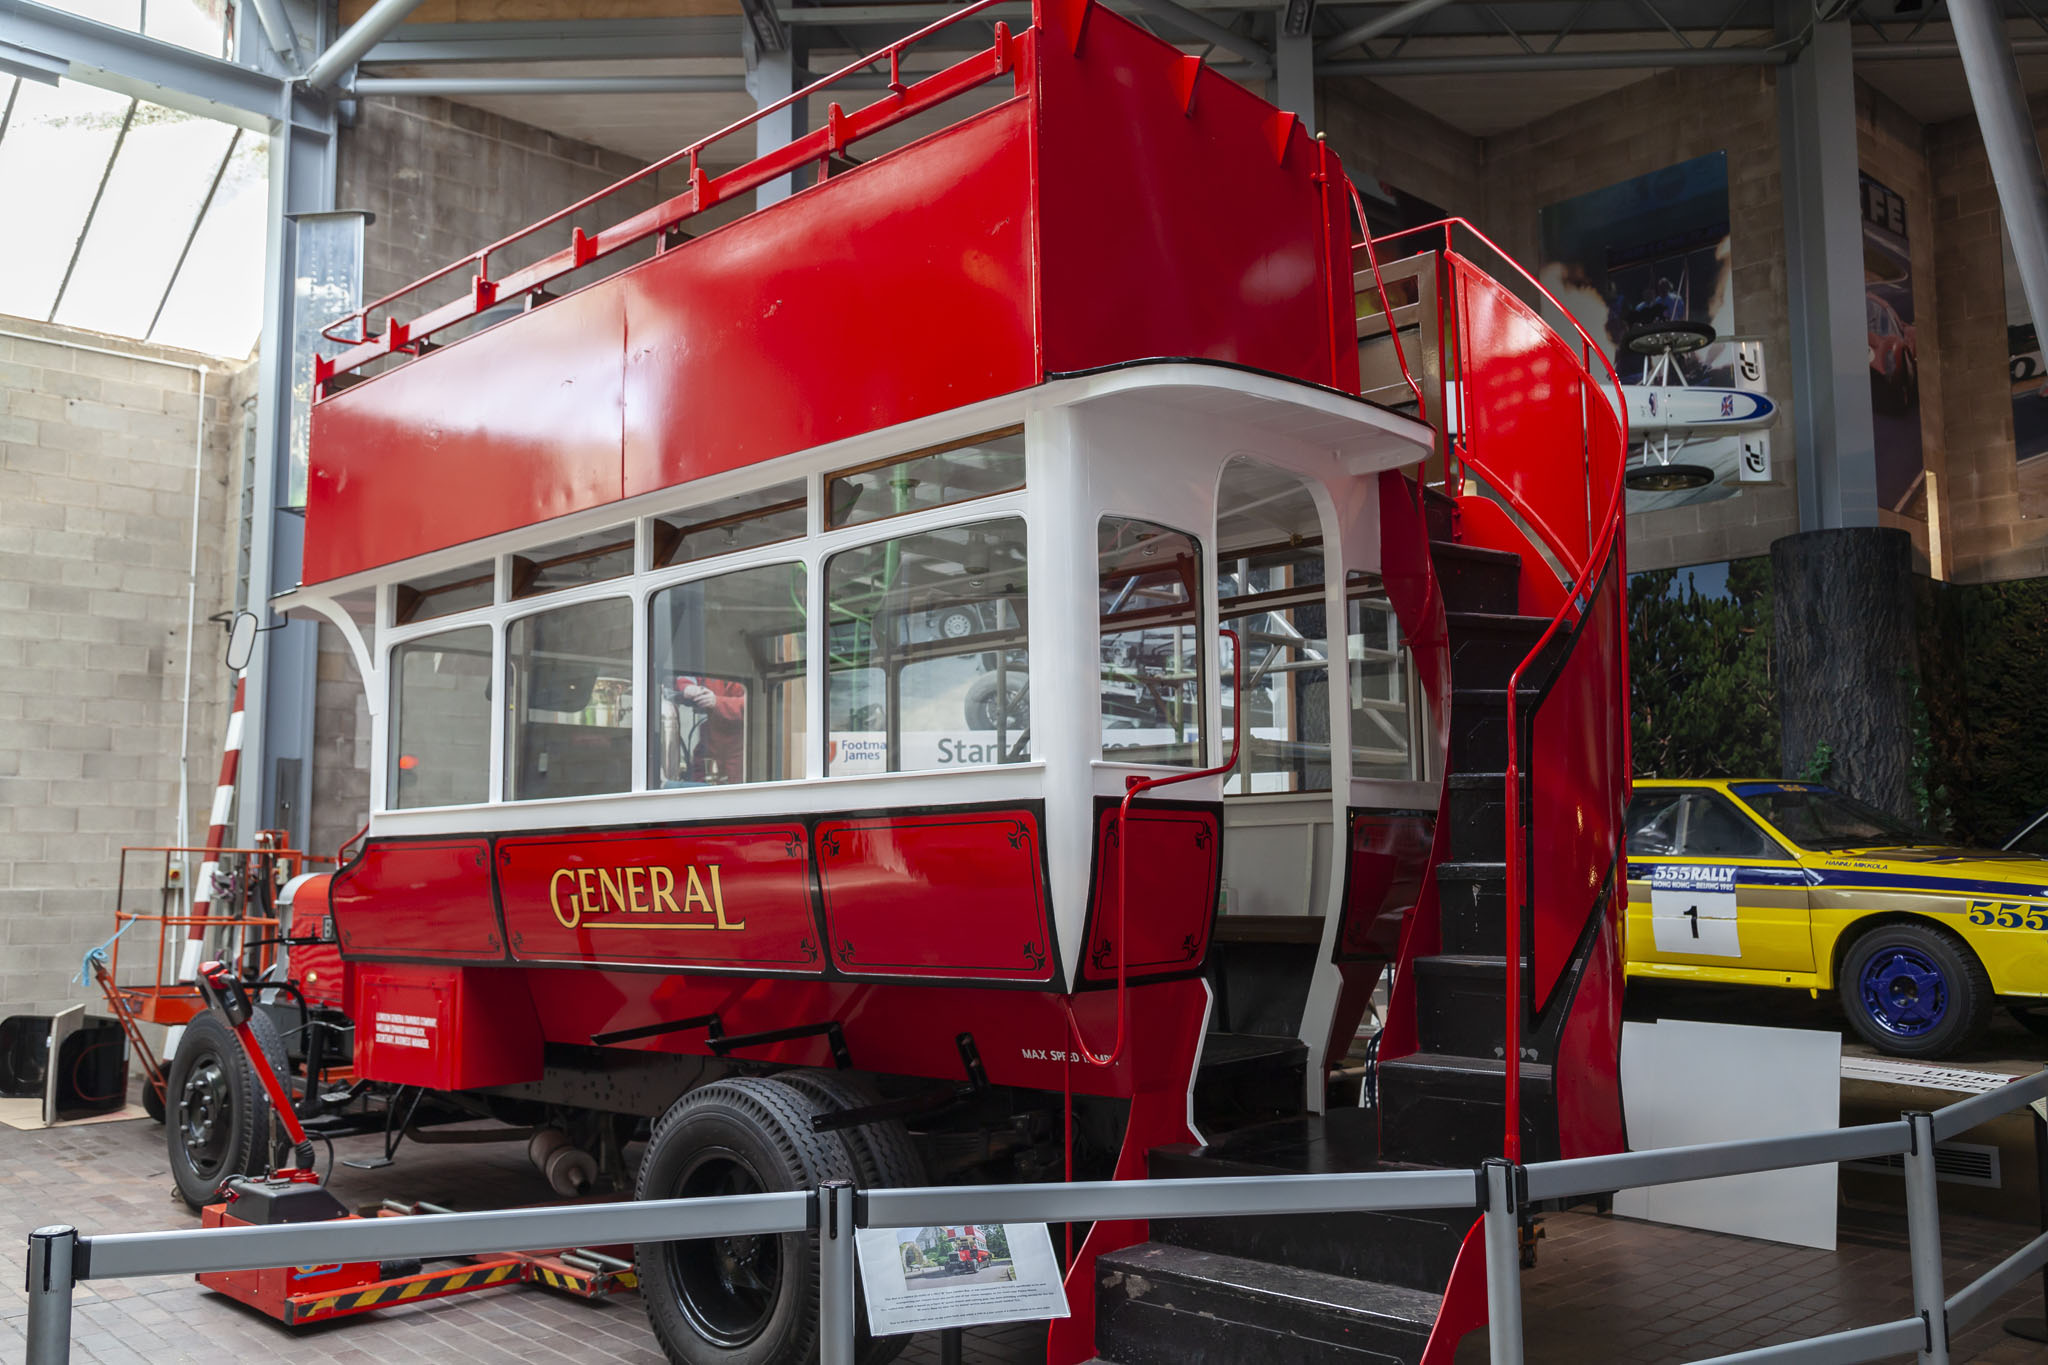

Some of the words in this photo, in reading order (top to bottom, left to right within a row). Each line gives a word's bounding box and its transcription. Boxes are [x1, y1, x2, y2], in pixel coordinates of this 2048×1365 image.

[844, 750, 880, 763] James
[1853, 861, 1888, 870] MIKKOLA
[1652, 880, 1671, 889] HONG
[549, 864, 746, 931] GENERAL
[1683, 905, 1699, 939] 1
[1968, 900, 2048, 931] 555
[1021, 1048, 1048, 1060] MAX
[1924, 1070, 2006, 1083] LIVERP
